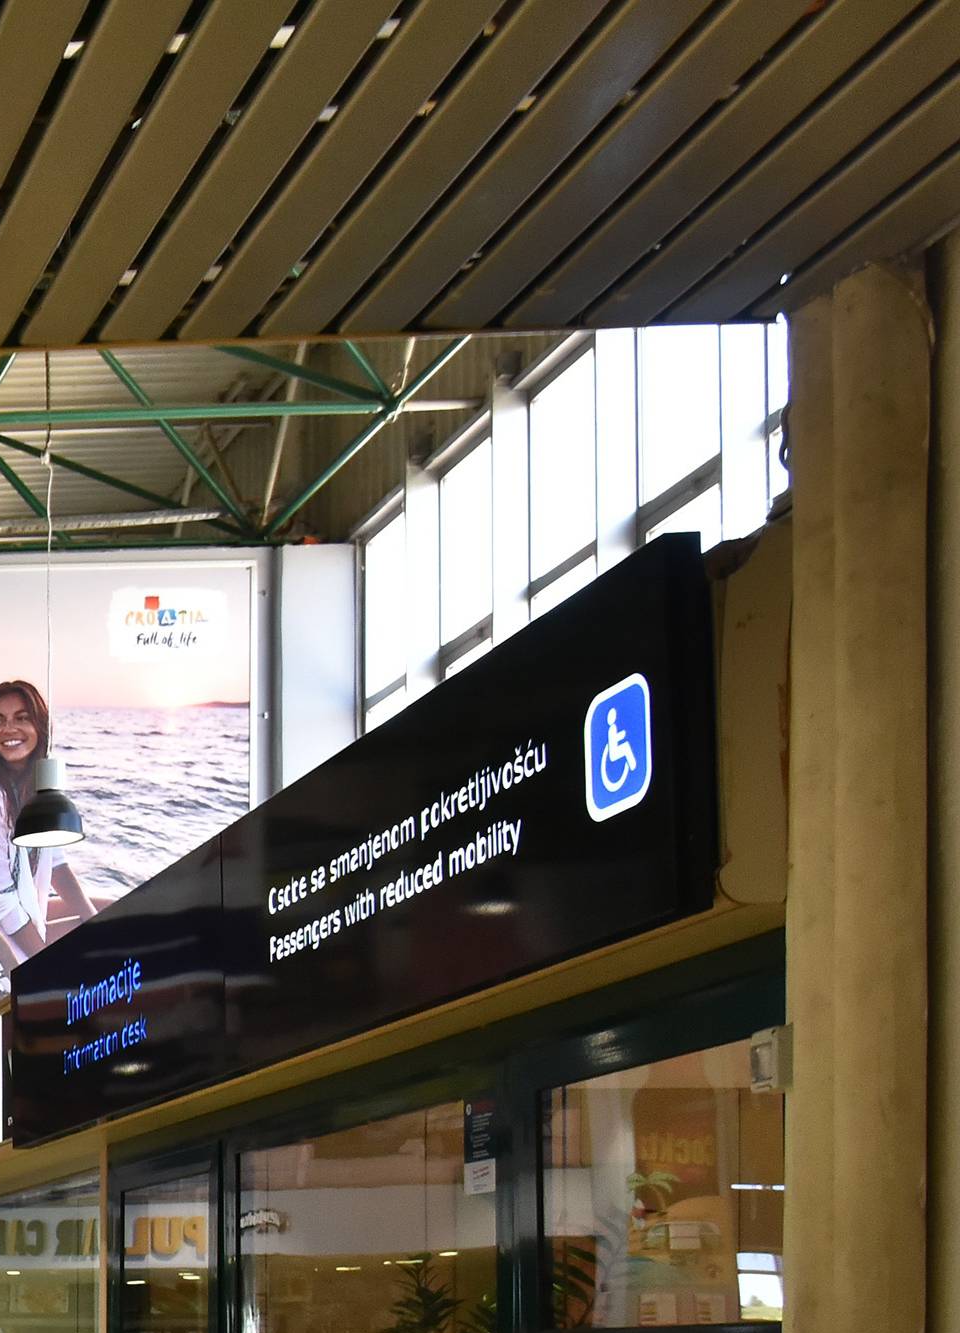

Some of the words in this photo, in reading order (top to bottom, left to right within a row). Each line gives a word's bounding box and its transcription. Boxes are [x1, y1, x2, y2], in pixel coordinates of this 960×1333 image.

[125, 609, 208, 627] CROATIA
[180, 631, 197, 647] life
[329, 815, 415, 883] smanjenom
[420, 738, 547, 841] pokretljivošću
[269, 908, 341, 963] Passengers
[344, 886, 376, 928] with
[379, 851, 443, 910] reduced
[448, 818, 522, 878] mobility
[66, 957, 142, 1025] Informacije
[121, 1012, 147, 1049] desk
